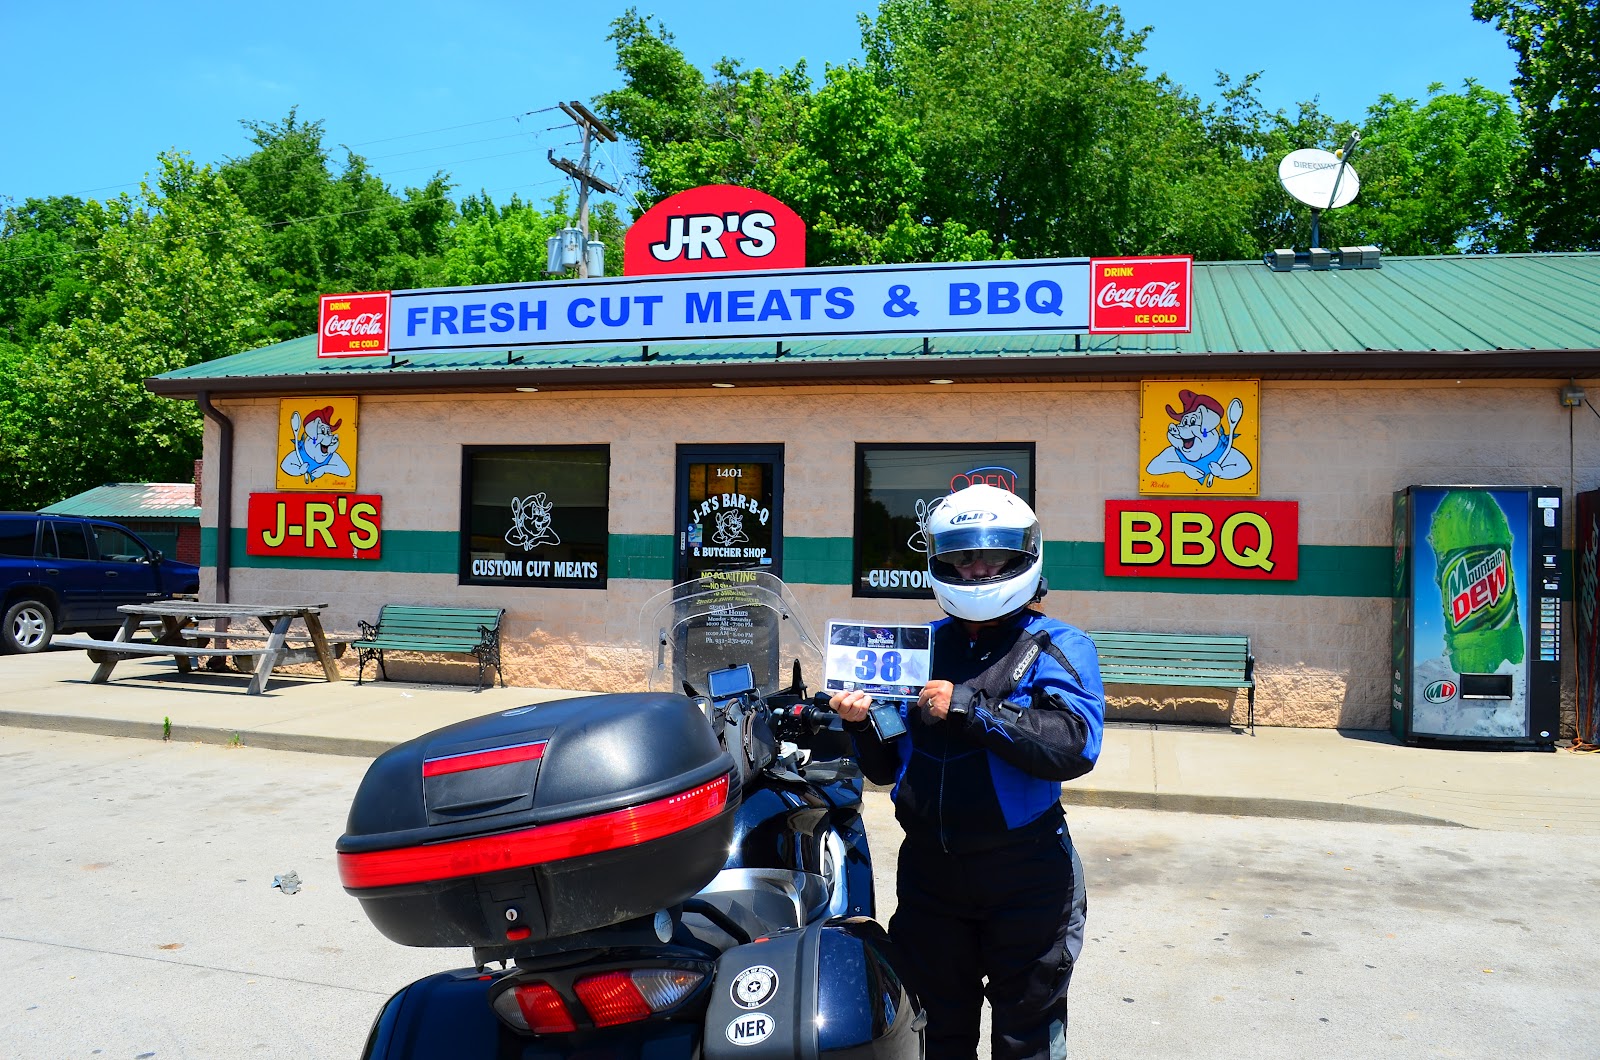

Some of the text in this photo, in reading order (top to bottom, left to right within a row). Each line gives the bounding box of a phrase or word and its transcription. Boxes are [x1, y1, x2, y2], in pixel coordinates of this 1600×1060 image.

[1104, 268, 1134, 277] DRINK
[330, 302, 351, 310] DRINK
[1097, 281, 1180, 309] Coca-Cola
[407, 280, 1064, 337] FRESH CUT MEATS & BBQ
[1134, 315, 1177, 323] ICE COLD
[324, 313, 383, 337] Coca-Cola
[361, 340, 379, 348] COLD
[716, 468, 743, 478] 1401
[693, 493, 769, 526] J-R'S BAR-B-Q
[262, 496, 379, 550] J-R'S
[693, 547, 767, 558] & BUTCHER SHOP
[1119, 510, 1276, 573] BBQ
[472, 560, 598, 579] CUSTOM CUT MEATS
[1449, 550, 1503, 613] Mountain
[855, 650, 902, 682] 38
[734, 1018, 766, 1039] NER
